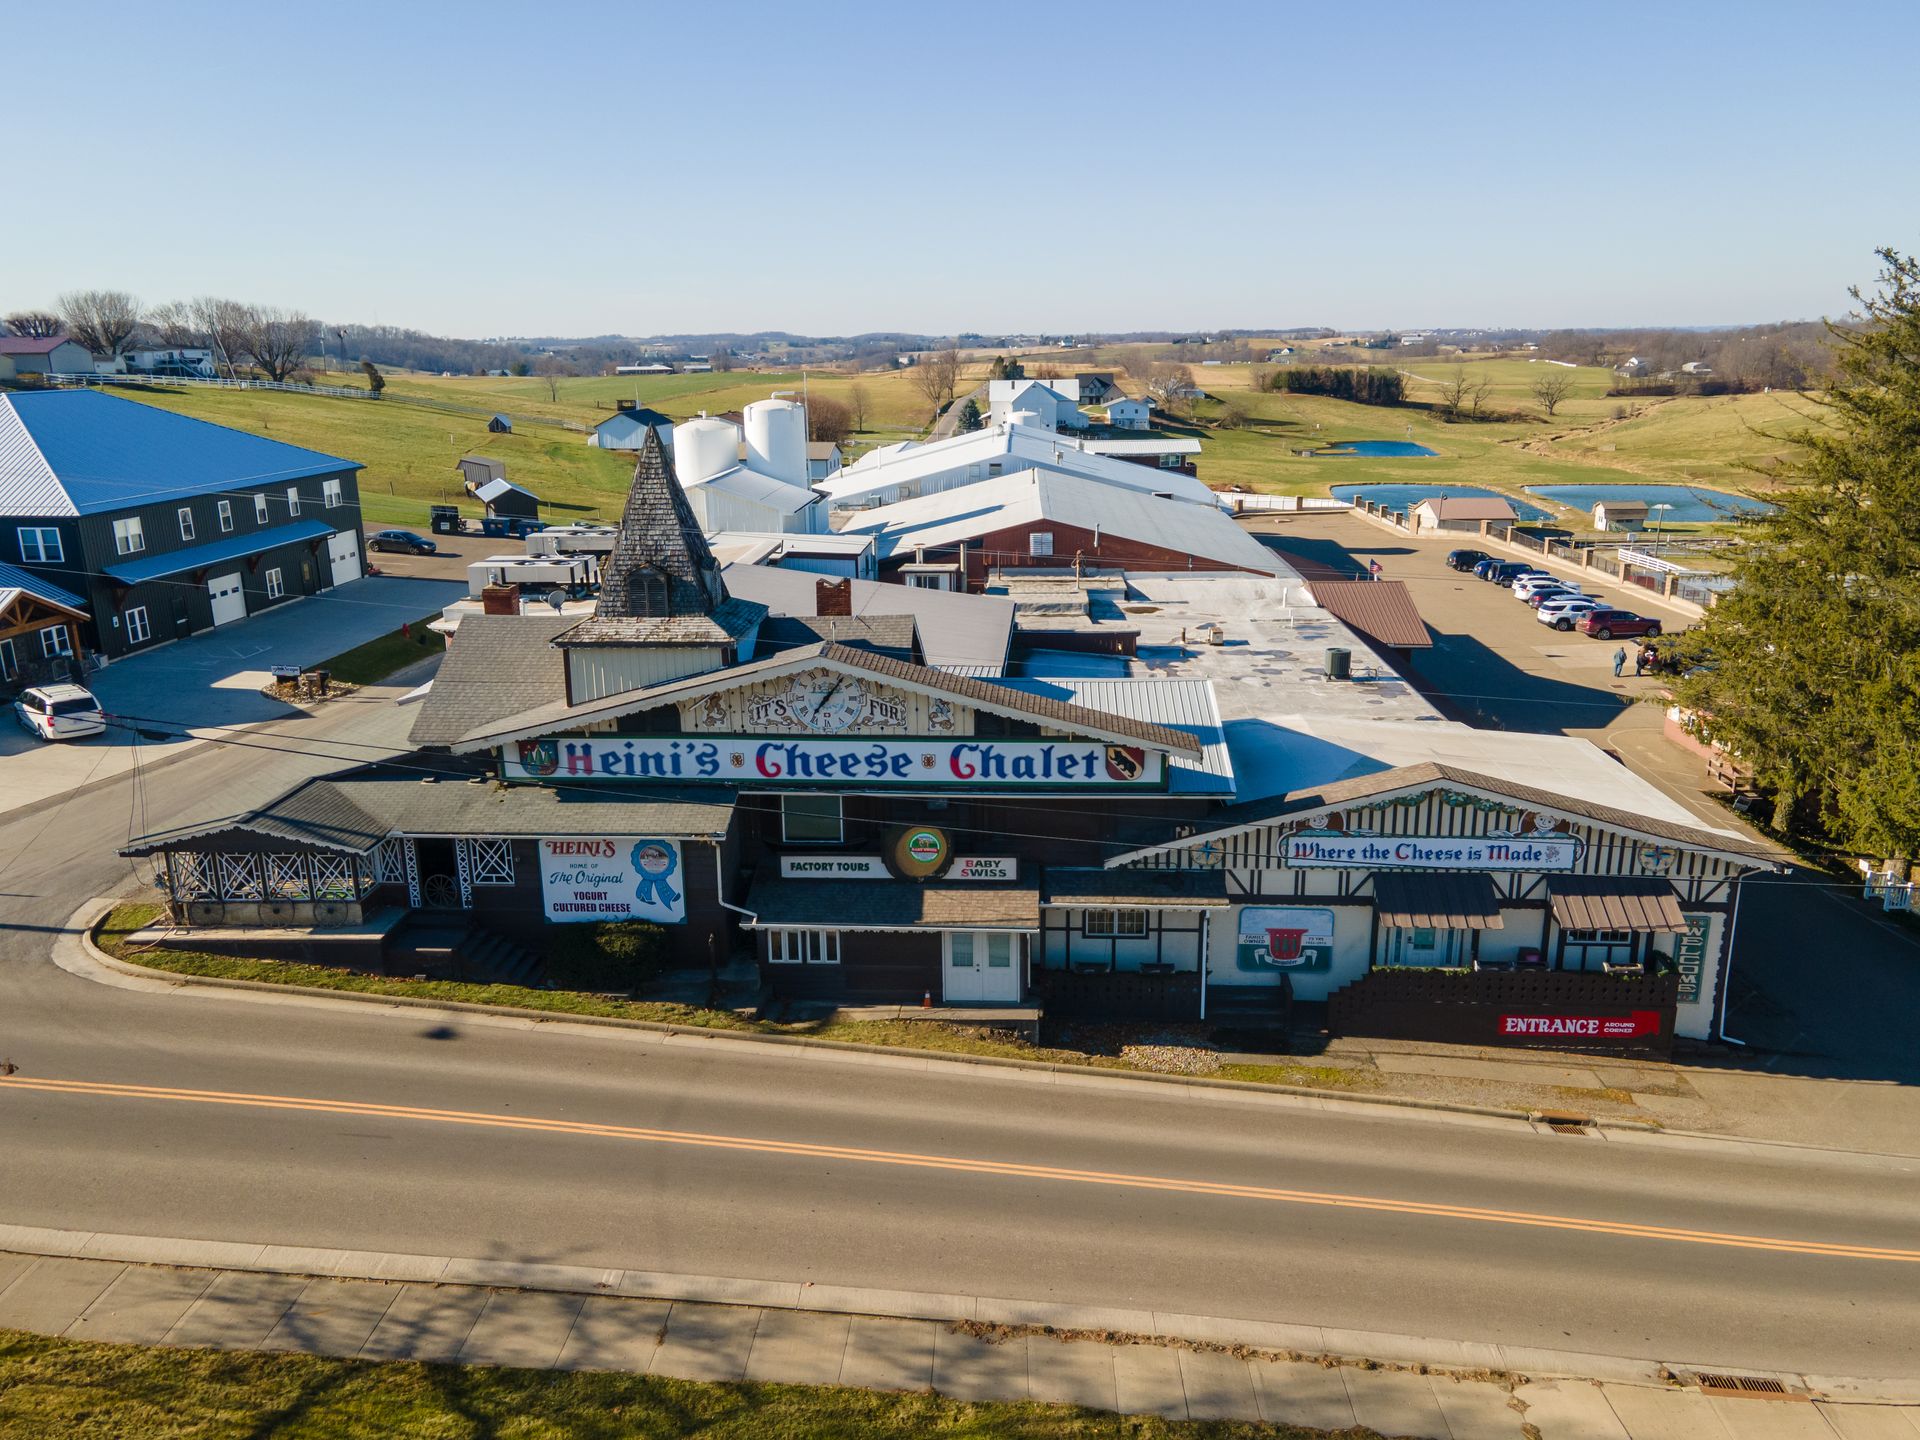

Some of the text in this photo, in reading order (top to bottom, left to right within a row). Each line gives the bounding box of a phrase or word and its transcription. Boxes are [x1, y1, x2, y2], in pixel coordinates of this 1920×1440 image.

[756, 699, 900, 721] IT'S FOR
[565, 741, 1099, 780] Heini's Cheese Chalet
[545, 839, 616, 858] HEINI'S
[1294, 842, 1542, 861] Where the Cheese is Made
[790, 862, 870, 872] FACTORY TOURS
[961, 868, 1006, 877] SWISS
[550, 870, 624, 888] The Original
[574, 892, 608, 900] YOGURT
[553, 902, 632, 913] CULTURED CHEESE
[1678, 927, 1706, 993] WELCOME
[1505, 1018, 1599, 1034] ENTRANCE
